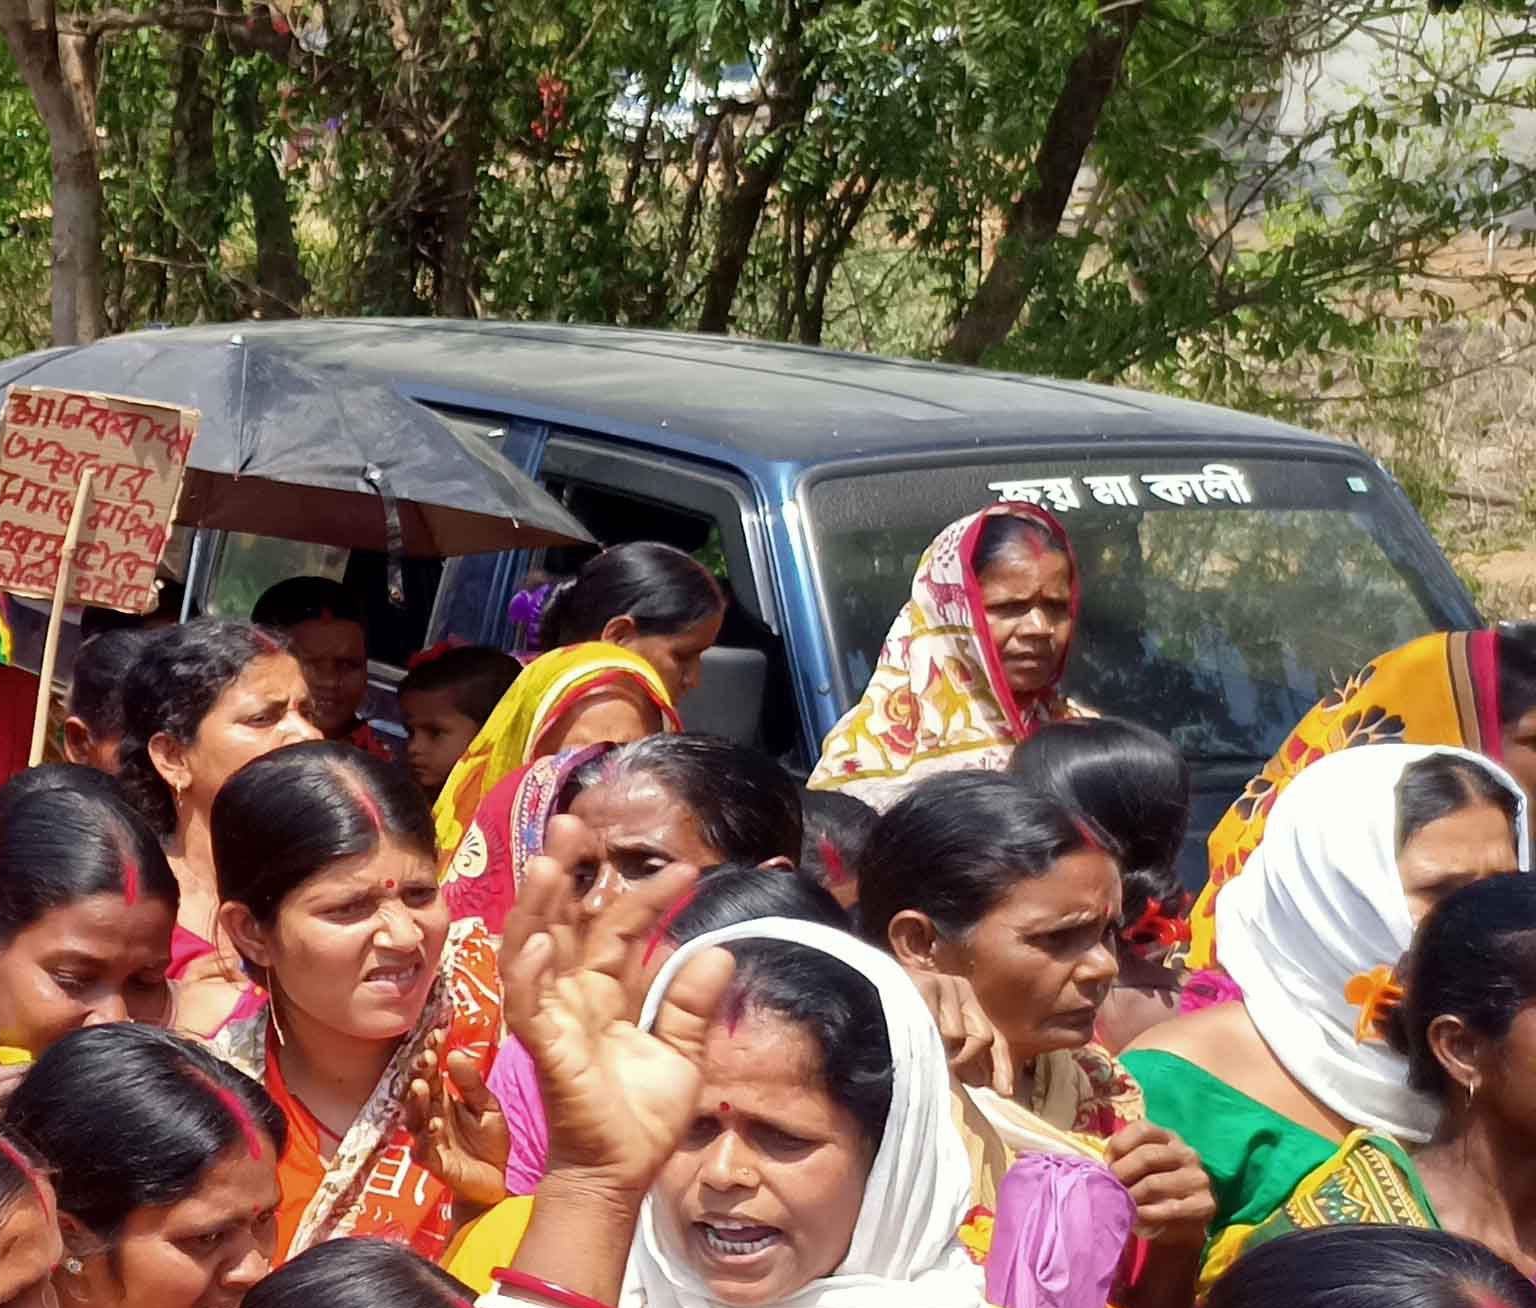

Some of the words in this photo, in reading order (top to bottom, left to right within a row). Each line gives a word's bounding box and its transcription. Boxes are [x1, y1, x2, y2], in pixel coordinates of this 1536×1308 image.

[988, 476, 1081, 513] জয়
[1082, 475, 1139, 507] মা
[1141, 464, 1252, 505] কালী
